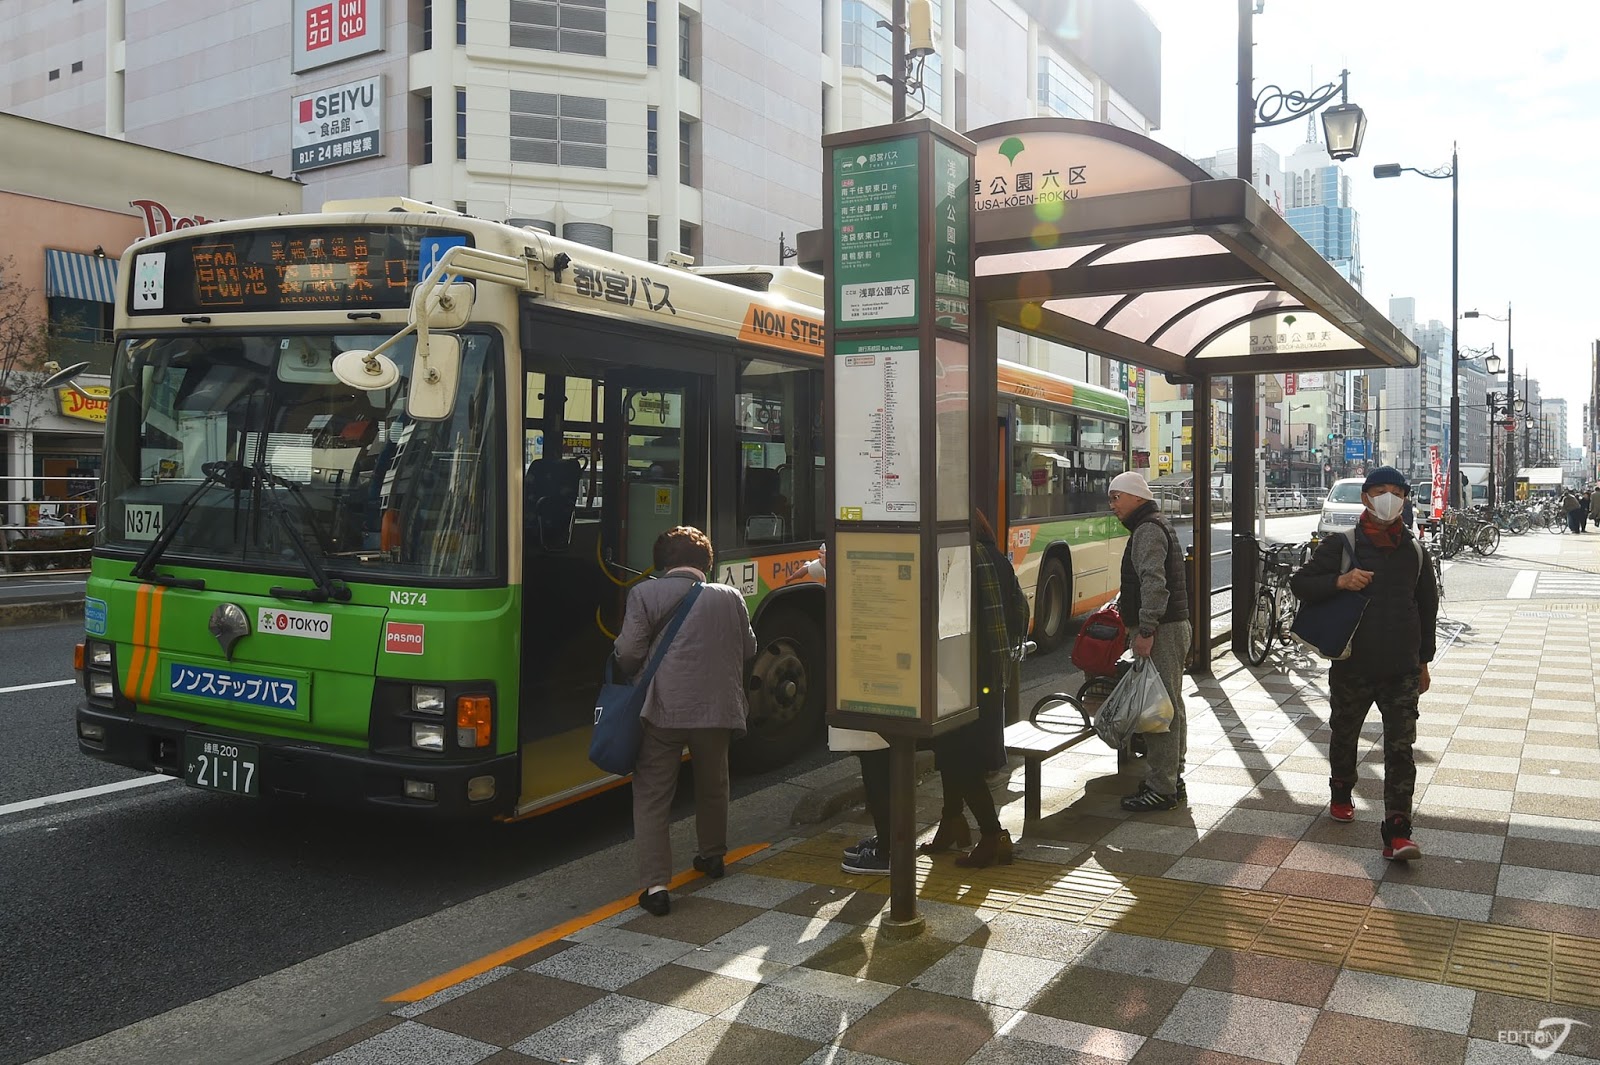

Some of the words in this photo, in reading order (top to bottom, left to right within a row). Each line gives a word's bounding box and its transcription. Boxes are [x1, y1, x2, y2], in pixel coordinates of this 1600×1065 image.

[342, 0, 361, 18] UNI
[310, 10, 328, 28] ユニ
[342, 18, 363, 37] QLO
[309, 27, 329, 45] クロ
[316, 84, 373, 119] SEIYU
[321, 117, 350, 138] 食品館
[300, 151, 314, 164] B1F
[318, 137, 372, 161] 24時間営業
[870, 151, 898, 162] 都営バス
[842, 184, 887, 196] 南千住駅東口
[842, 203, 888, 215] 南千住車庫前
[946, 158, 957, 288] 浅草公園六区
[841, 232, 879, 242] 池袋駅東口
[573, 266, 676, 314] 都営バス
[859, 285, 910, 298] 浅草公園六区
[753, 308, 785, 338] NON
[126, 510, 161, 533] N374
[725, 564, 754, 585] 入口
[390, 590, 427, 605] N374
[388, 633, 422, 644] PASMO
[172, 669, 295, 706] ノンステップバス
[198, 755, 255, 792] 21-17
